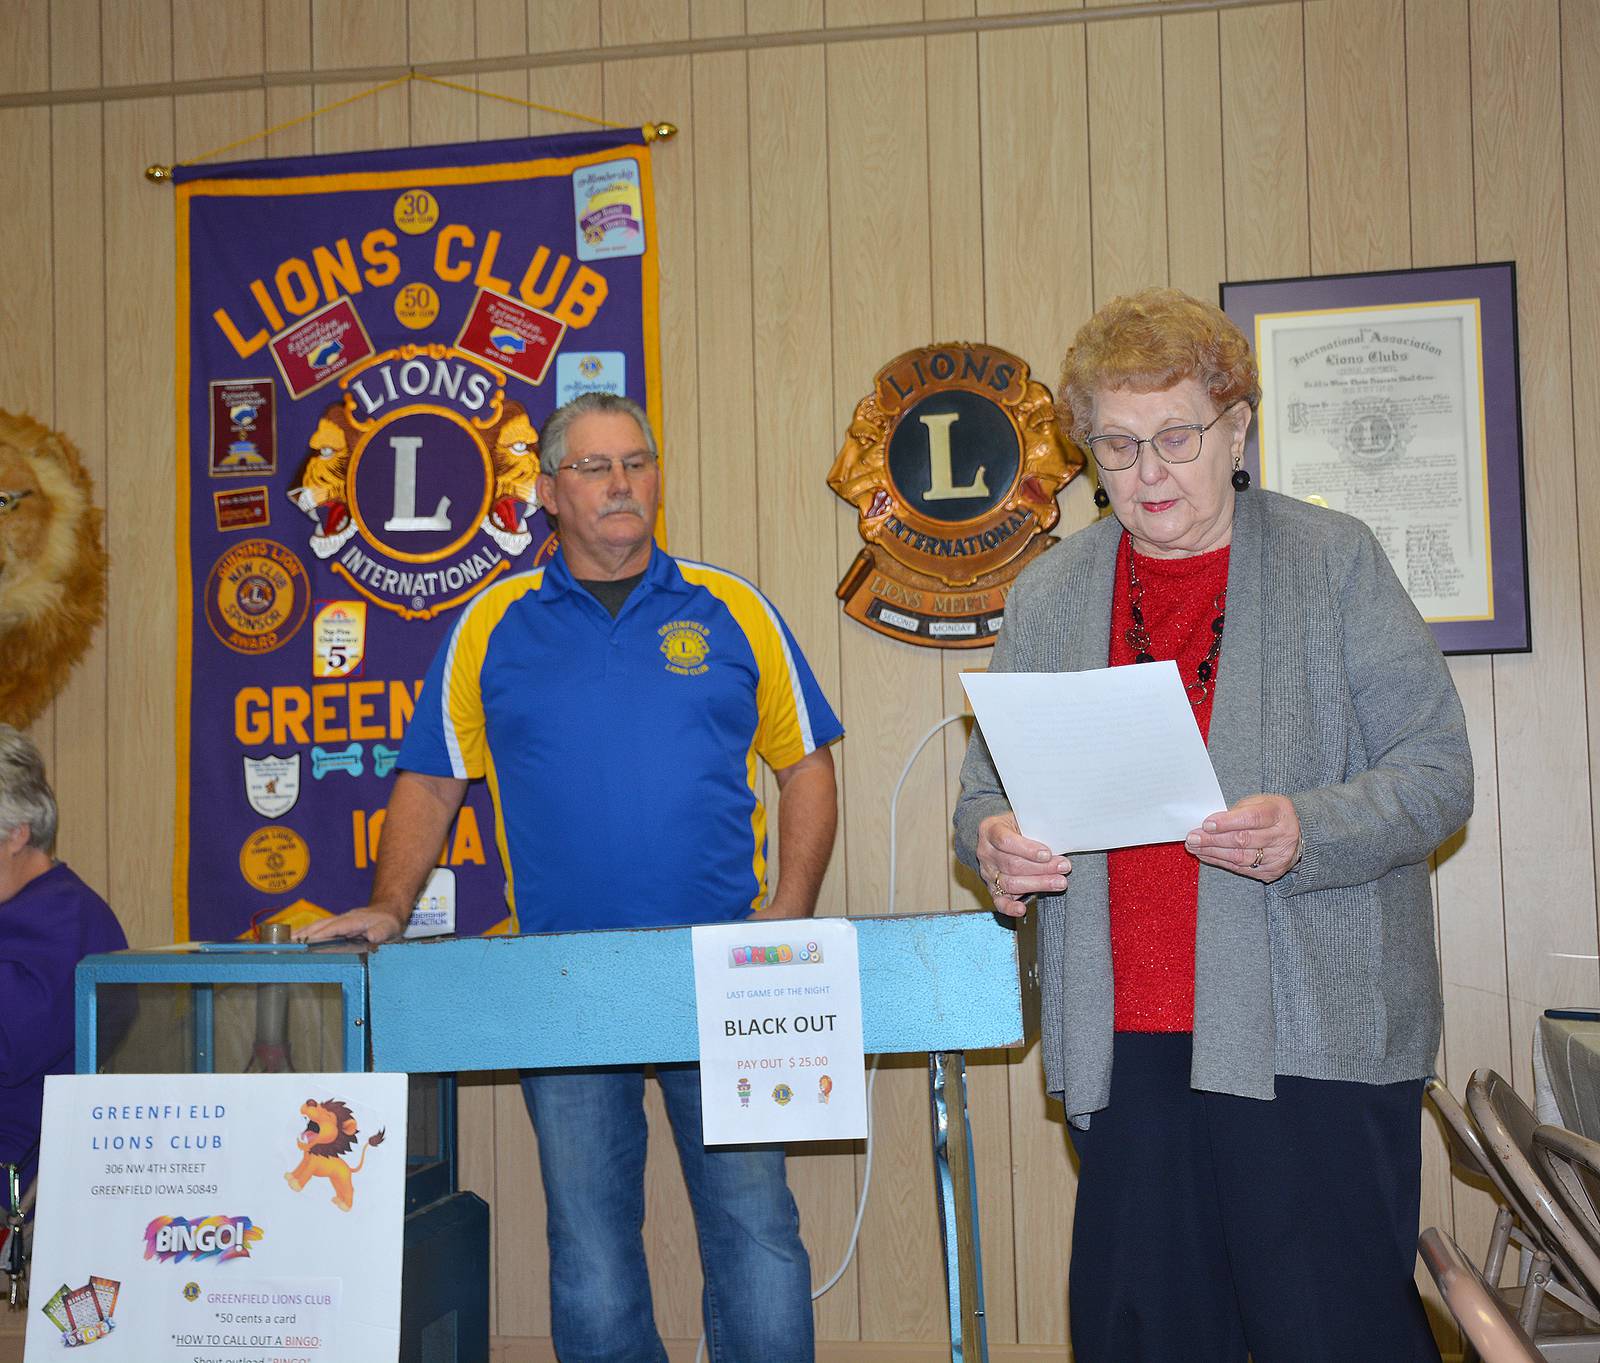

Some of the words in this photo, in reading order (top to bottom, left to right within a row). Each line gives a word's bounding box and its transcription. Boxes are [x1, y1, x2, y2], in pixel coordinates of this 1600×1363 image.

[403, 194, 429, 216] 30
[213, 228, 401, 358] LIONS
[434, 224, 608, 330] CLUB
[404, 286, 430, 308] 50
[1289, 328, 1364, 367] International
[1370, 331, 1443, 356] Association
[1325, 354, 1364, 366] Lions
[1368, 349, 1409, 363] Clubs
[352, 360, 492, 414] LIONS
[887, 351, 1016, 401] LIONS
[919, 412, 990, 501] L
[384, 436, 452, 532] L
[883, 509, 1034, 557] INTERNATIONAL
[341, 546, 502, 596] INTERNATIONAL
[870, 576, 922, 608] LIONS
[933, 593, 989, 612] MEET
[882, 611, 915, 629] SECOND
[328, 646, 347, 668] 5
[235, 681, 425, 745] GREEN
[732, 944, 793, 966] BINGO
[726, 990, 744, 999] LAST
[747, 989, 771, 998] GAME
[774, 988, 784, 996] OF
[787, 987, 803, 996] THE
[804, 985, 830, 995] NIGHT
[725, 1017, 788, 1036] BLACK
[794, 1014, 837, 1033] OUT
[737, 1058, 757, 1070] PAY
[760, 1058, 783, 1069] OUT
[788, 1056, 796, 1069] $
[799, 1056, 829, 1067] 25.00
[92, 1105, 226, 1120] GREENFIELD
[92, 1136, 154, 1150] LIONS
[170, 1135, 222, 1149] CLUB
[105, 1164, 123, 1174] 306
[125, 1164, 145, 1174] NW
[147, 1163, 167, 1173] 4TH
[170, 1163, 206, 1173] STREET
[91, 1185, 152, 1196] GREENFIELD
[155, 1185, 184, 1195] IOWA
[186, 1184, 218, 1195] 50849
[155, 1222, 245, 1252] BINGO!
[207, 1293, 269, 1304] GREENFIELD
[272, 1294, 302, 1305] LIONS
[304, 1295, 332, 1305] CLUB
[235, 1314, 263, 1324] cents
[265, 1316, 271, 1324] a
[274, 1313, 296, 1324] card
[206, 1335, 220, 1345] TO
[223, 1335, 247, 1345] CALL
[250, 1335, 272, 1346] OUT
[275, 1336, 282, 1345] A
[285, 1336, 323, 1347] BINGO:
